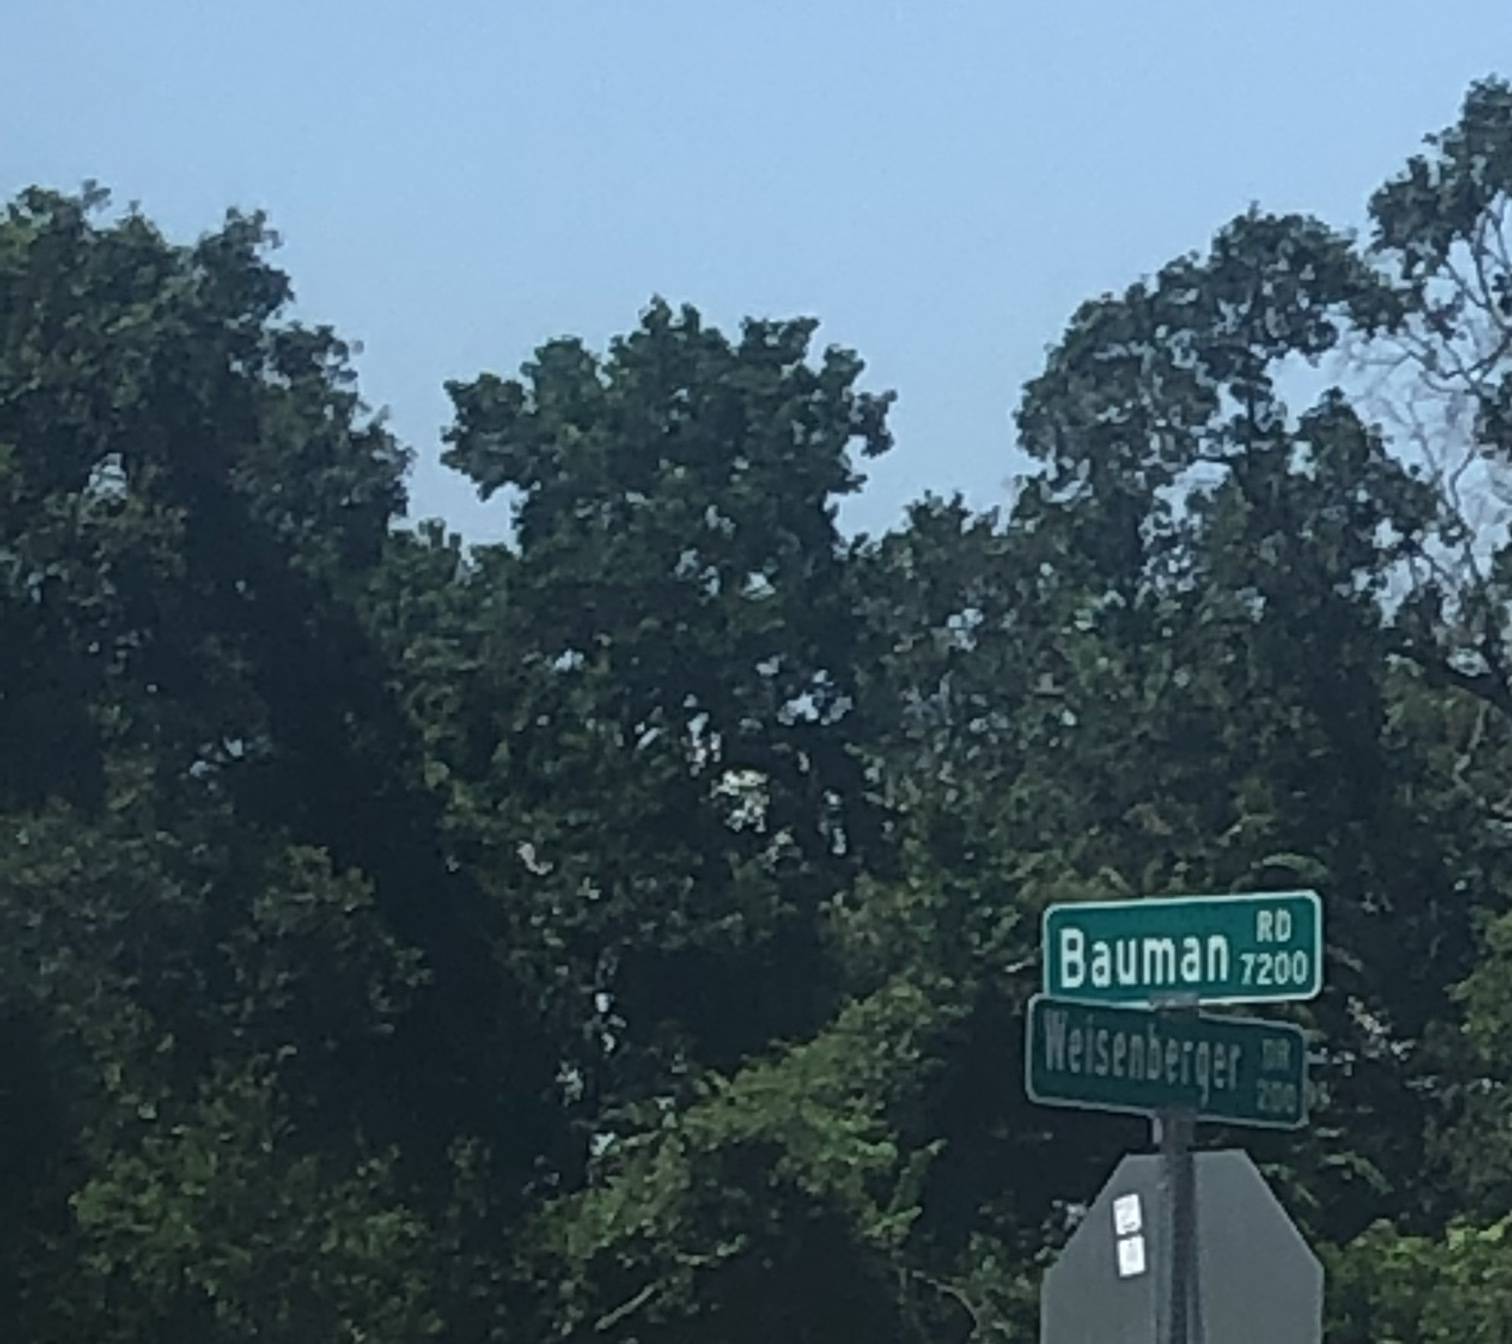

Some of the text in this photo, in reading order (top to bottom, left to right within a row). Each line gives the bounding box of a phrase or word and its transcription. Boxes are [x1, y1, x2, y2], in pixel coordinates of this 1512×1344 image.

[1256, 908, 1292, 942] RD
[1060, 927, 1228, 988] Bauman
[1239, 950, 1308, 985] 7200
[1043, 1010, 1242, 1108] Weisenberger
